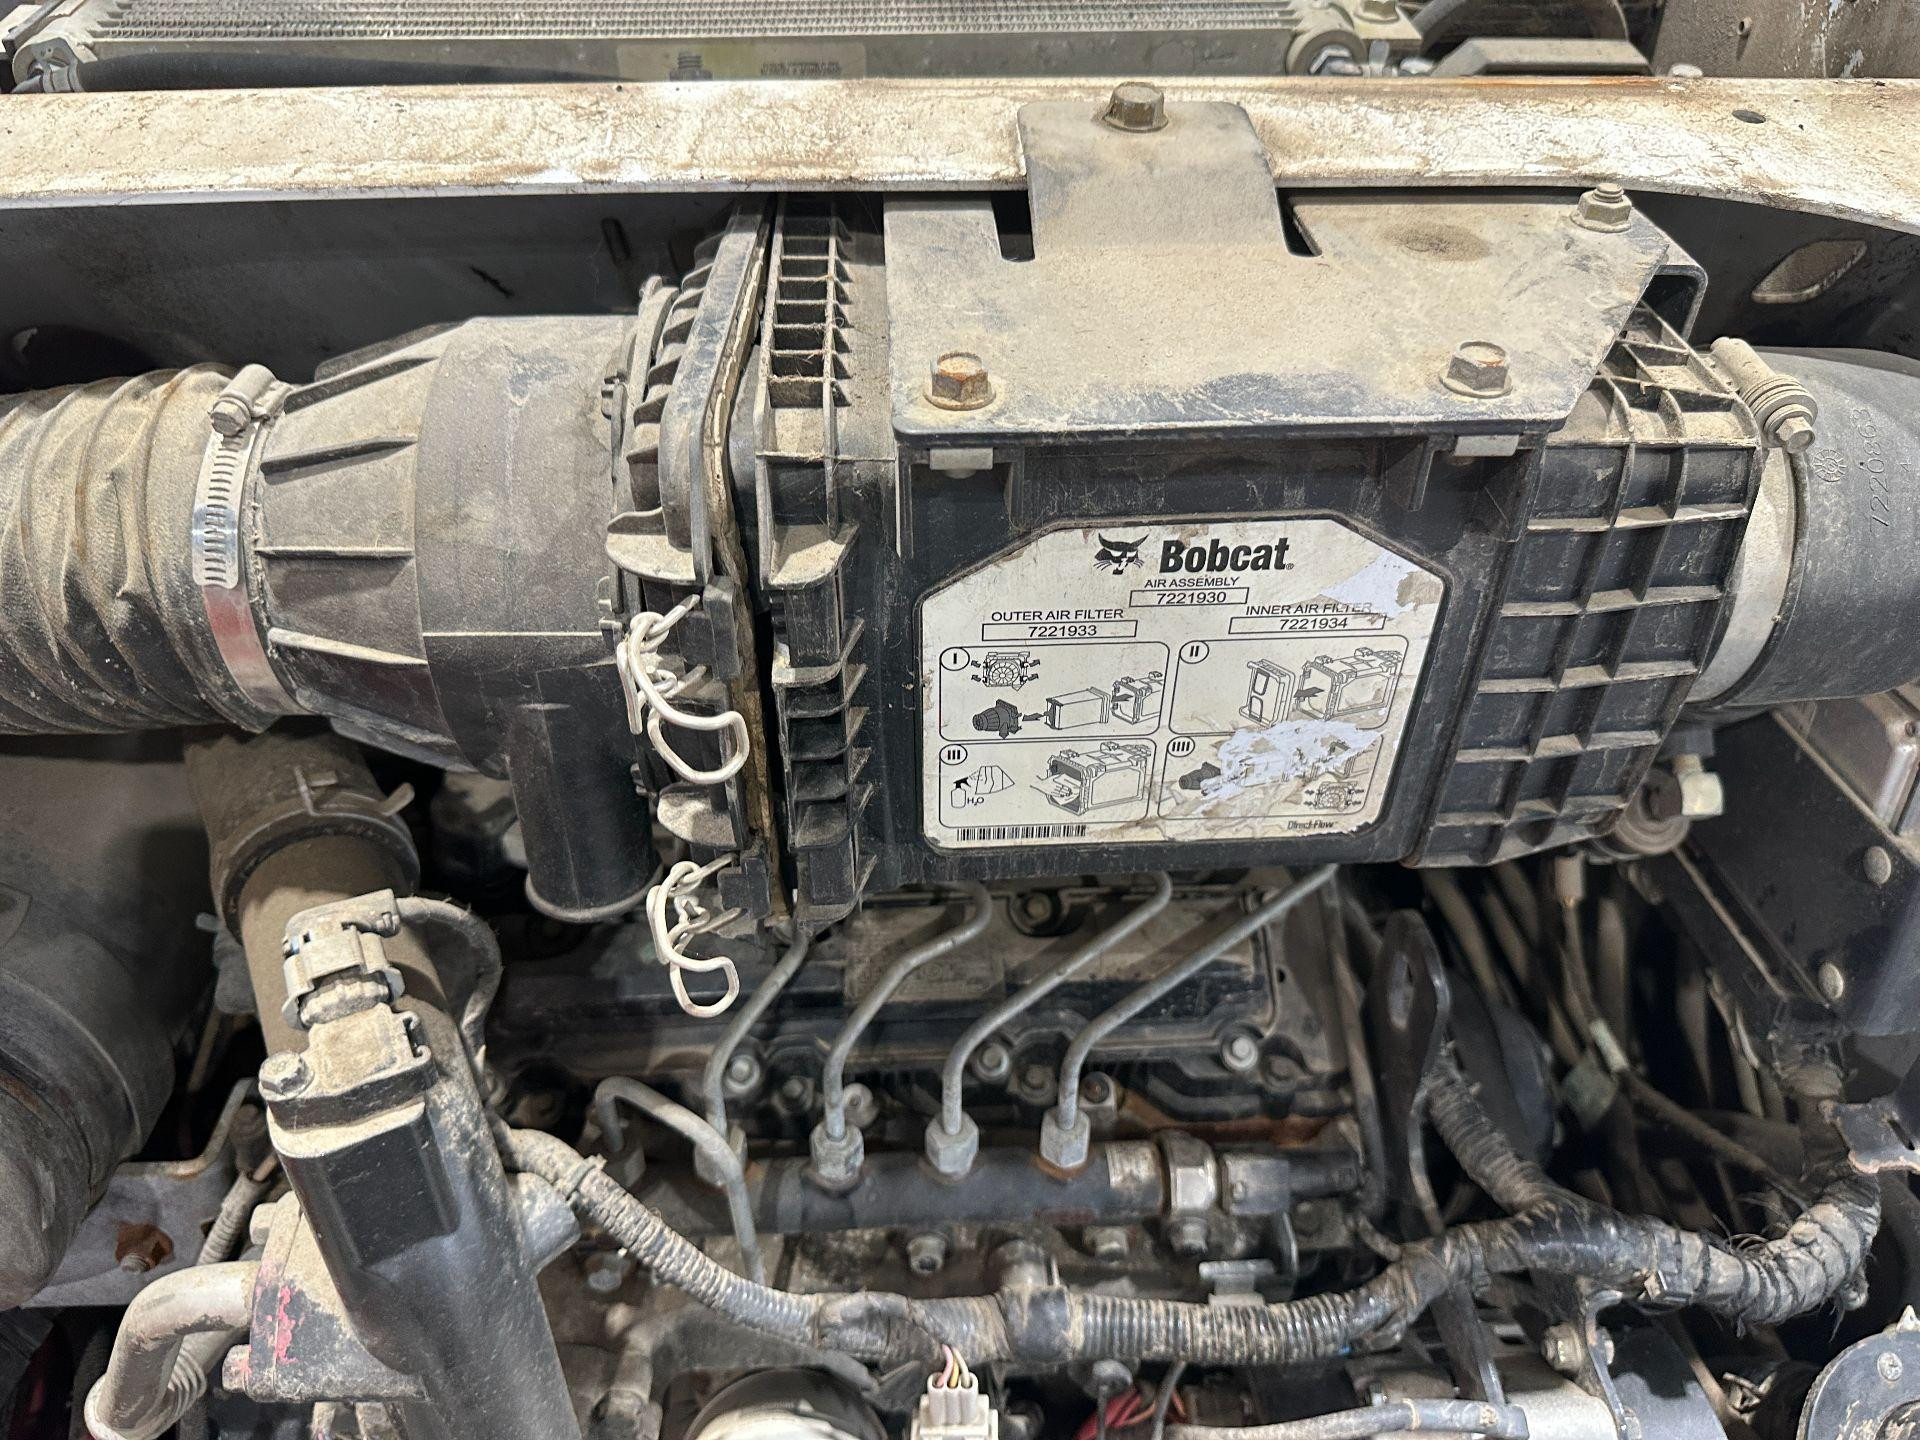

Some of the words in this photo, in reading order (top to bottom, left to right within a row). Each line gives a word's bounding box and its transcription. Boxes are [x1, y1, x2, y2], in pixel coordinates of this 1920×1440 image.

[1159, 537, 1290, 573] Bobcat
[1144, 579, 1167, 588] AIR
[1169, 576, 1240, 588] ASSEMBLY
[1156, 591, 1227, 605] 7221930
[991, 611, 1042, 622] OUTER
[1045, 610, 1071, 621] AIR
[1074, 608, 1124, 619] FILTER
[1245, 604, 1291, 616] INNER
[1294, 603, 1319, 614] AIR
[1323, 601, 1373, 614] FILTER
[1279, 617, 1348, 631] 7221934
[1028, 625, 1097, 638] 7221933
